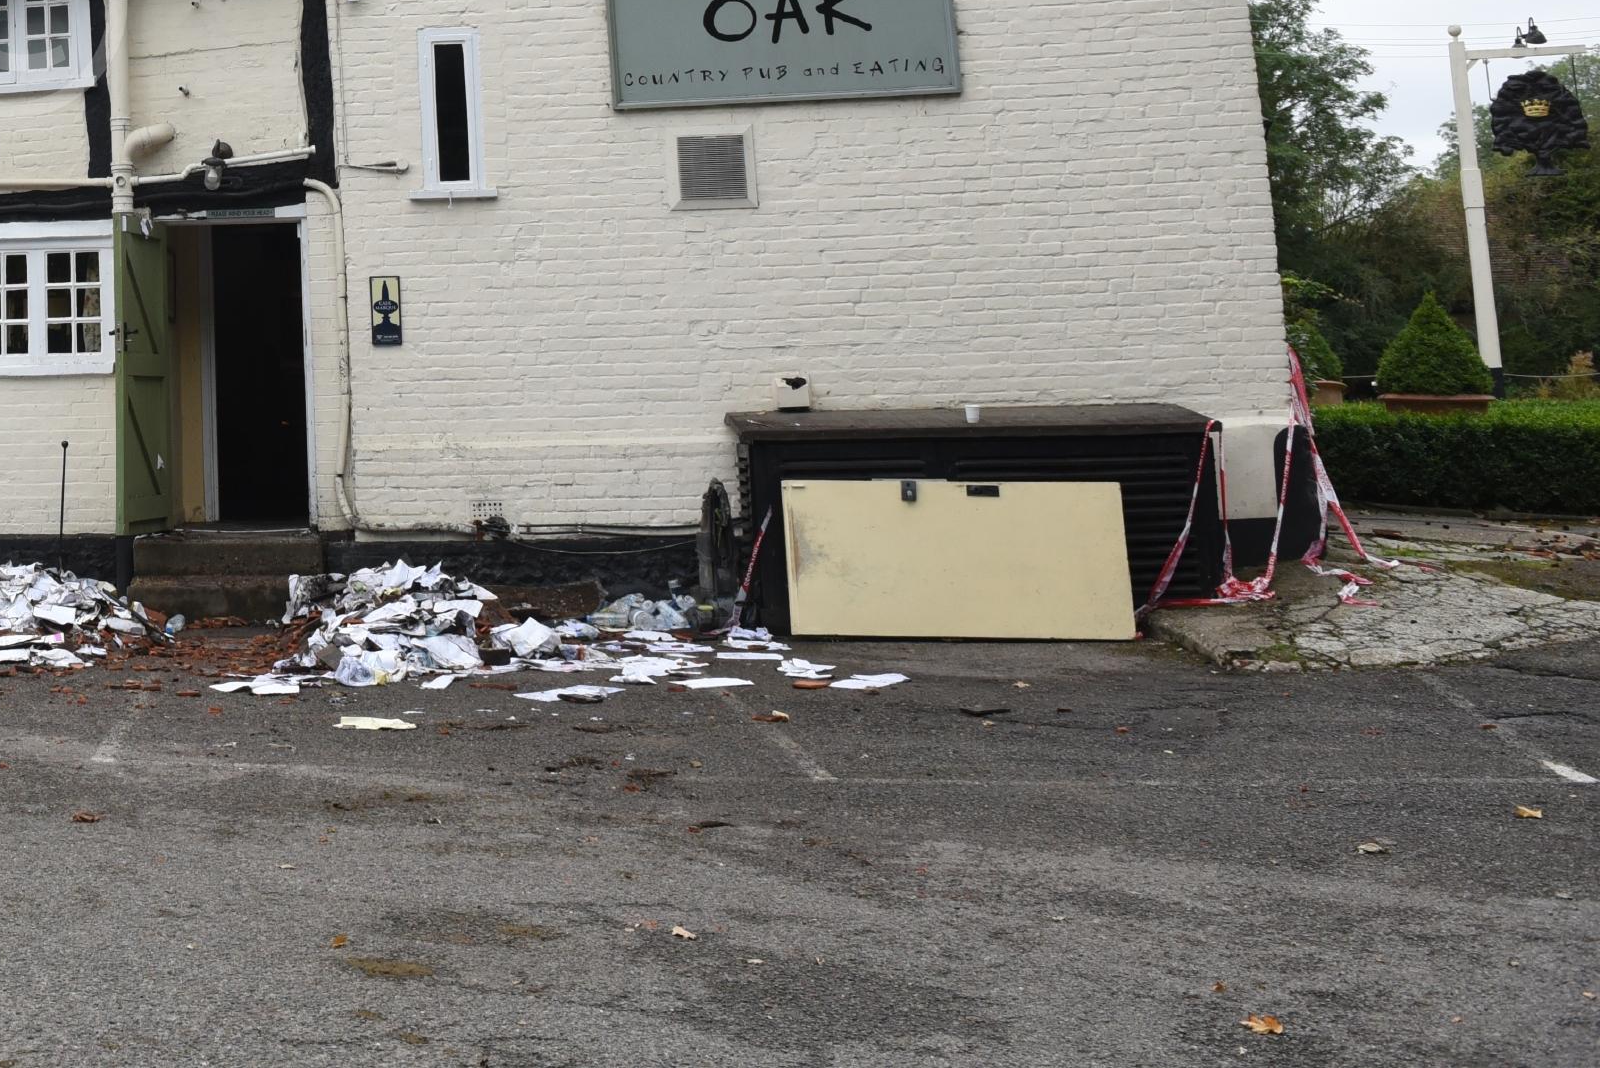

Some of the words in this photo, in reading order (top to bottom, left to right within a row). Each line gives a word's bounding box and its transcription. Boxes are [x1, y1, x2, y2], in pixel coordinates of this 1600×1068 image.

[624, 68, 729, 86] COUNTRY
[742, 64, 788, 80] PUB
[803, 62, 839, 77] and
[852, 57, 944, 76] EATING
